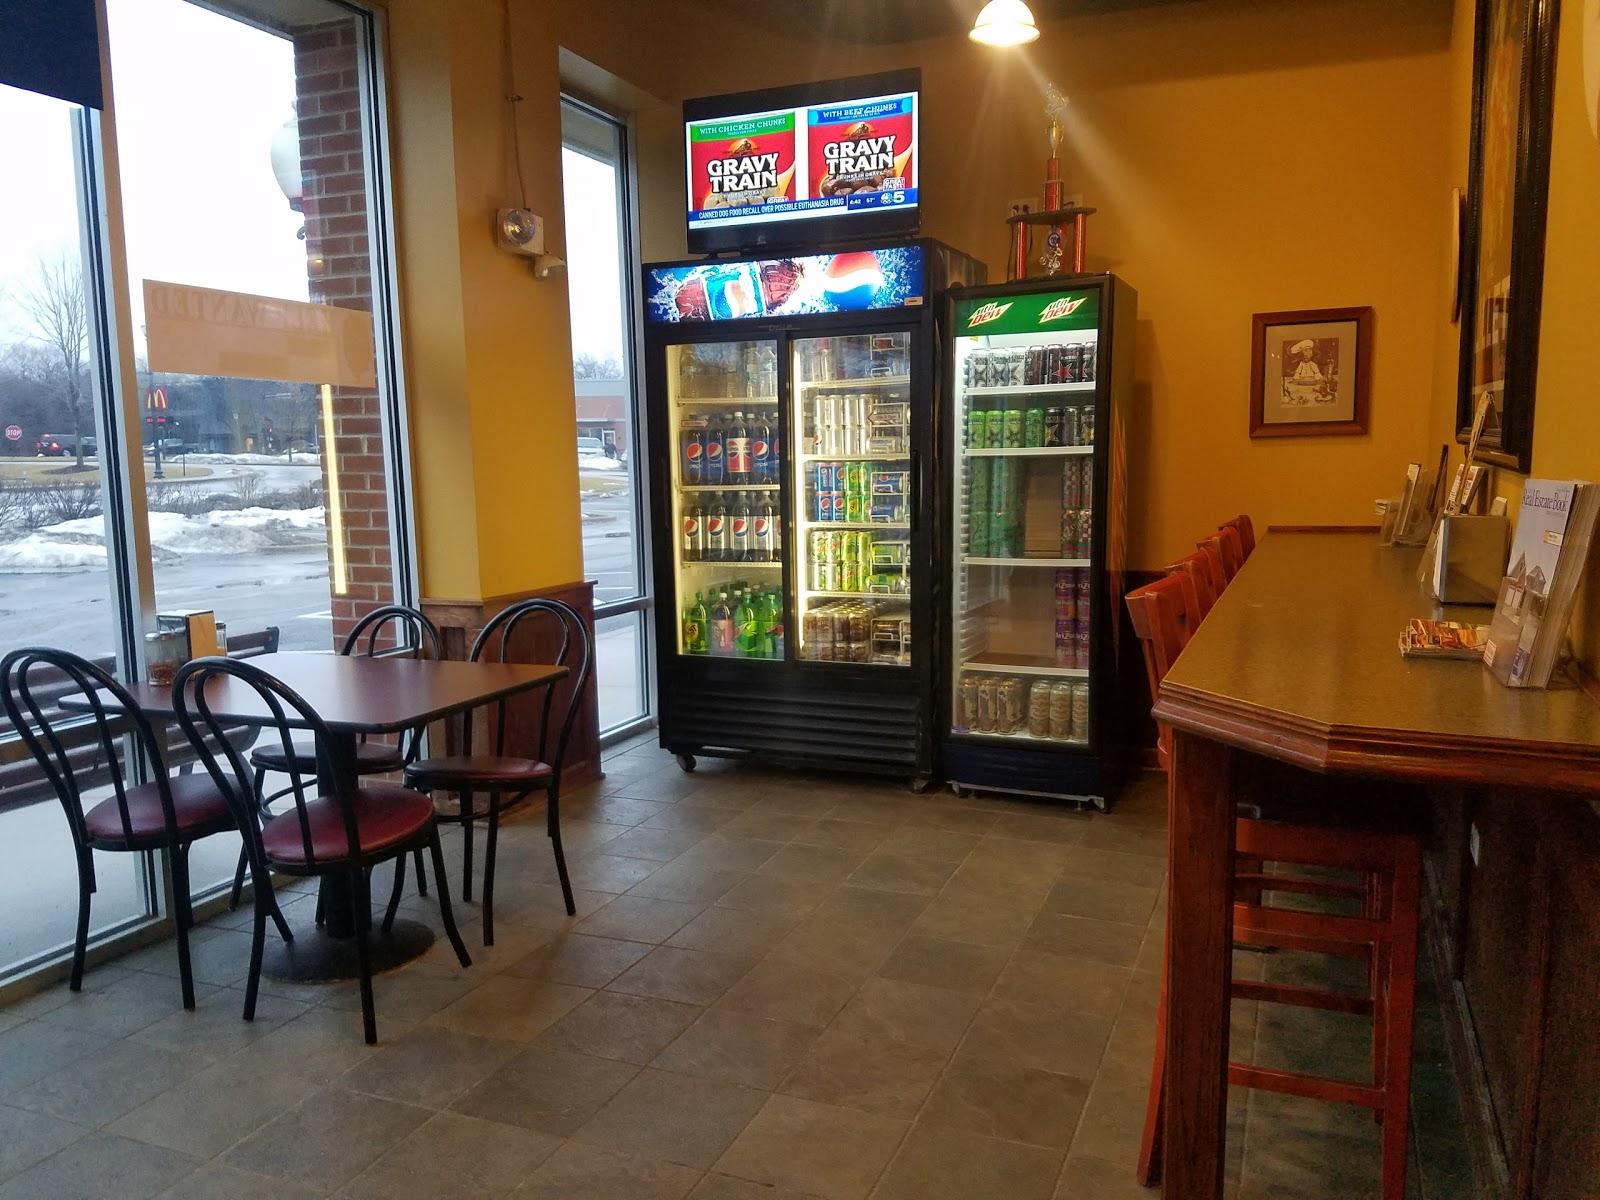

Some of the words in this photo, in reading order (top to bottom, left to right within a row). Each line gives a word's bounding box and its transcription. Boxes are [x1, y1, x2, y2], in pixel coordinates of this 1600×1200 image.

[844, 108, 863, 116] BEEF
[700, 126, 718, 135] WITH
[718, 123, 756, 133] CHICKEN
[757, 118, 786, 128] CHUNKS
[824, 135, 896, 159] GRAVY
[707, 152, 779, 177] GRAVY
[826, 152, 894, 175] TRAIN
[709, 169, 777, 193] TRAIN
[698, 210, 718, 219] CANNED
[719, 209, 729, 217] DOG
[729, 208, 742, 216] FOOD
[742, 206, 760, 215] RECALL
[761, 205, 774, 213] OVER
[775, 202, 798, 212] POSSIBLE
[798, 198, 830, 209] EUTHANASIA
[830, 197, 845, 206] DRUG
[893, 191, 905, 203] 5
